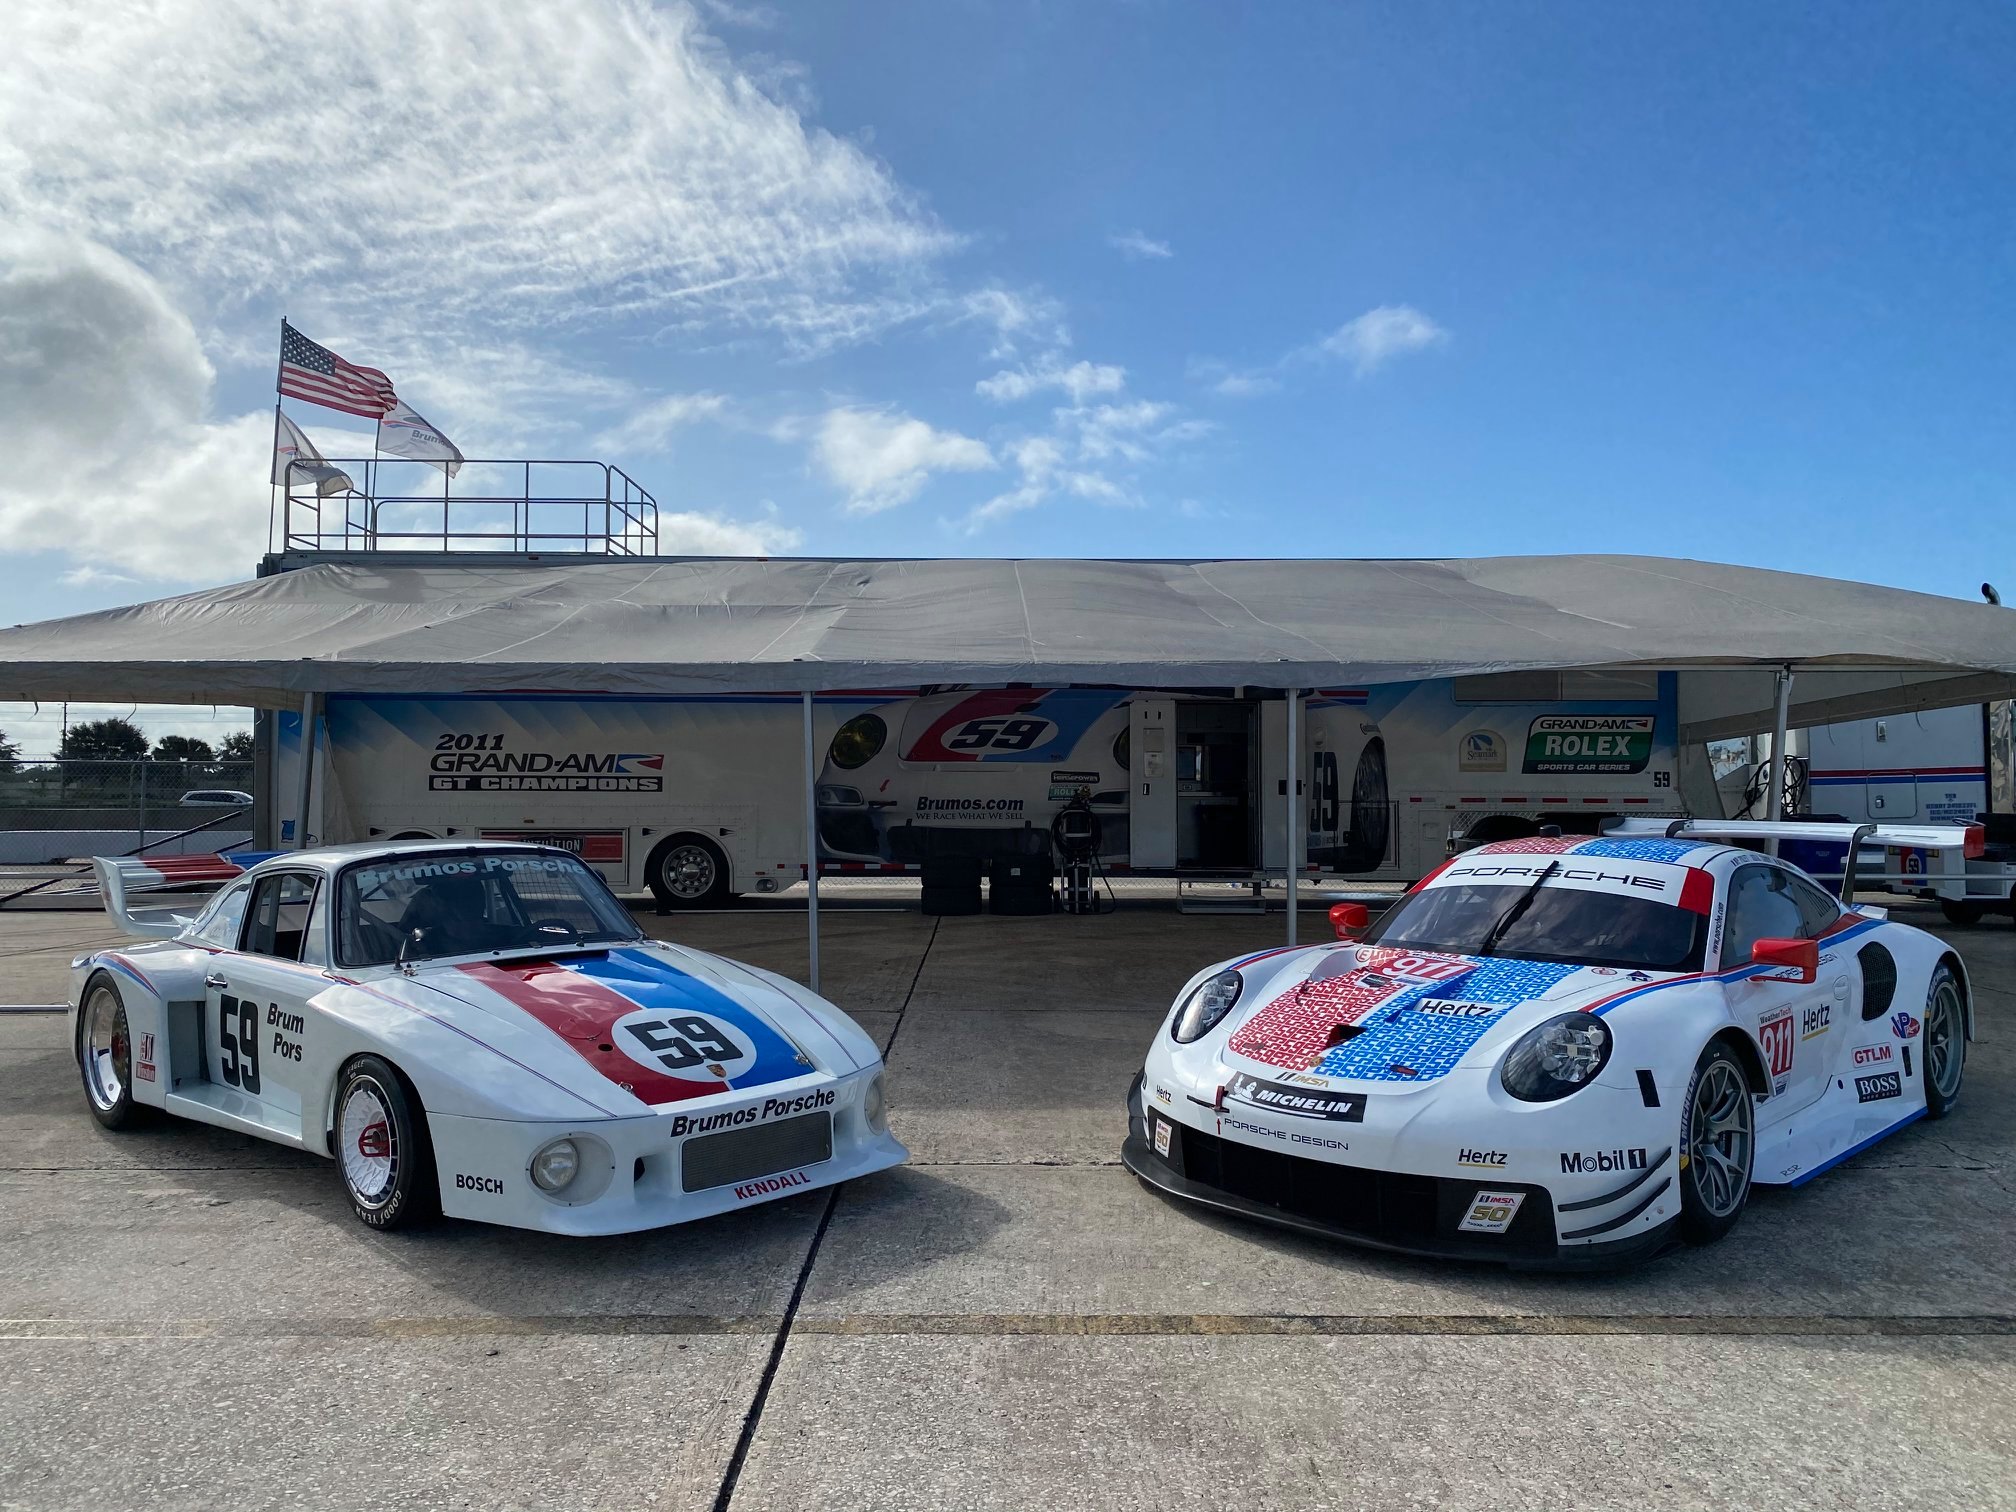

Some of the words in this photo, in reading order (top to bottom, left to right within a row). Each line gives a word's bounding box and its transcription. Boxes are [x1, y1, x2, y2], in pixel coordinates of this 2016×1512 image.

[435, 733, 505, 750] 2011
[948, 720, 1050, 750] 59
[1544, 735, 1632, 756] ROLEX
[430, 753, 616, 772] GRAND-AM
[432, 777, 470, 790] GT
[480, 777, 659, 791] CHAMPIONS
[1653, 771, 1671, 787] 59
[1310, 751, 1339, 832] 59
[916, 796, 1024, 812] Brumos.com
[356, 861, 478, 889] Brumos
[483, 857, 587, 876] Porsche
[1445, 867, 1666, 891] PORSCHE
[1382, 957, 1469, 979] 911
[267, 1002, 304, 1034] Brum
[1420, 998, 1494, 1018] Hertz
[1760, 1008, 1791, 1024] WeatherTech
[1803, 1003, 1831, 1035] Hertz
[219, 993, 260, 1096] 59
[273, 1032, 302, 1062] Pors
[624, 1016, 743, 1070] 59
[1762, 1019, 1792, 1072] 911
[1854, 1046, 1892, 1064] GTLM
[347, 1059, 365, 1075] EAGLE
[1292, 1075, 1329, 1088] IMSA
[1859, 1075, 1898, 1096] BOSS
[1156, 1084, 1172, 1102] Hertz
[1256, 1089, 1353, 1113] MICHELIN
[670, 1106, 758, 1137] Brumos
[762, 1088, 835, 1119] Porsche
[1156, 1130, 1168, 1148] 50
[1224, 1118, 1287, 1140] PORSCHE
[1291, 1134, 1349, 1150] DESIGN
[1458, 1149, 1508, 1165] Hertz
[1560, 1150, 1626, 1174] Mobil
[455, 1173, 504, 1195] BOSCH
[734, 1171, 811, 1200] KENDALL
[1470, 1205, 1512, 1221] 50
